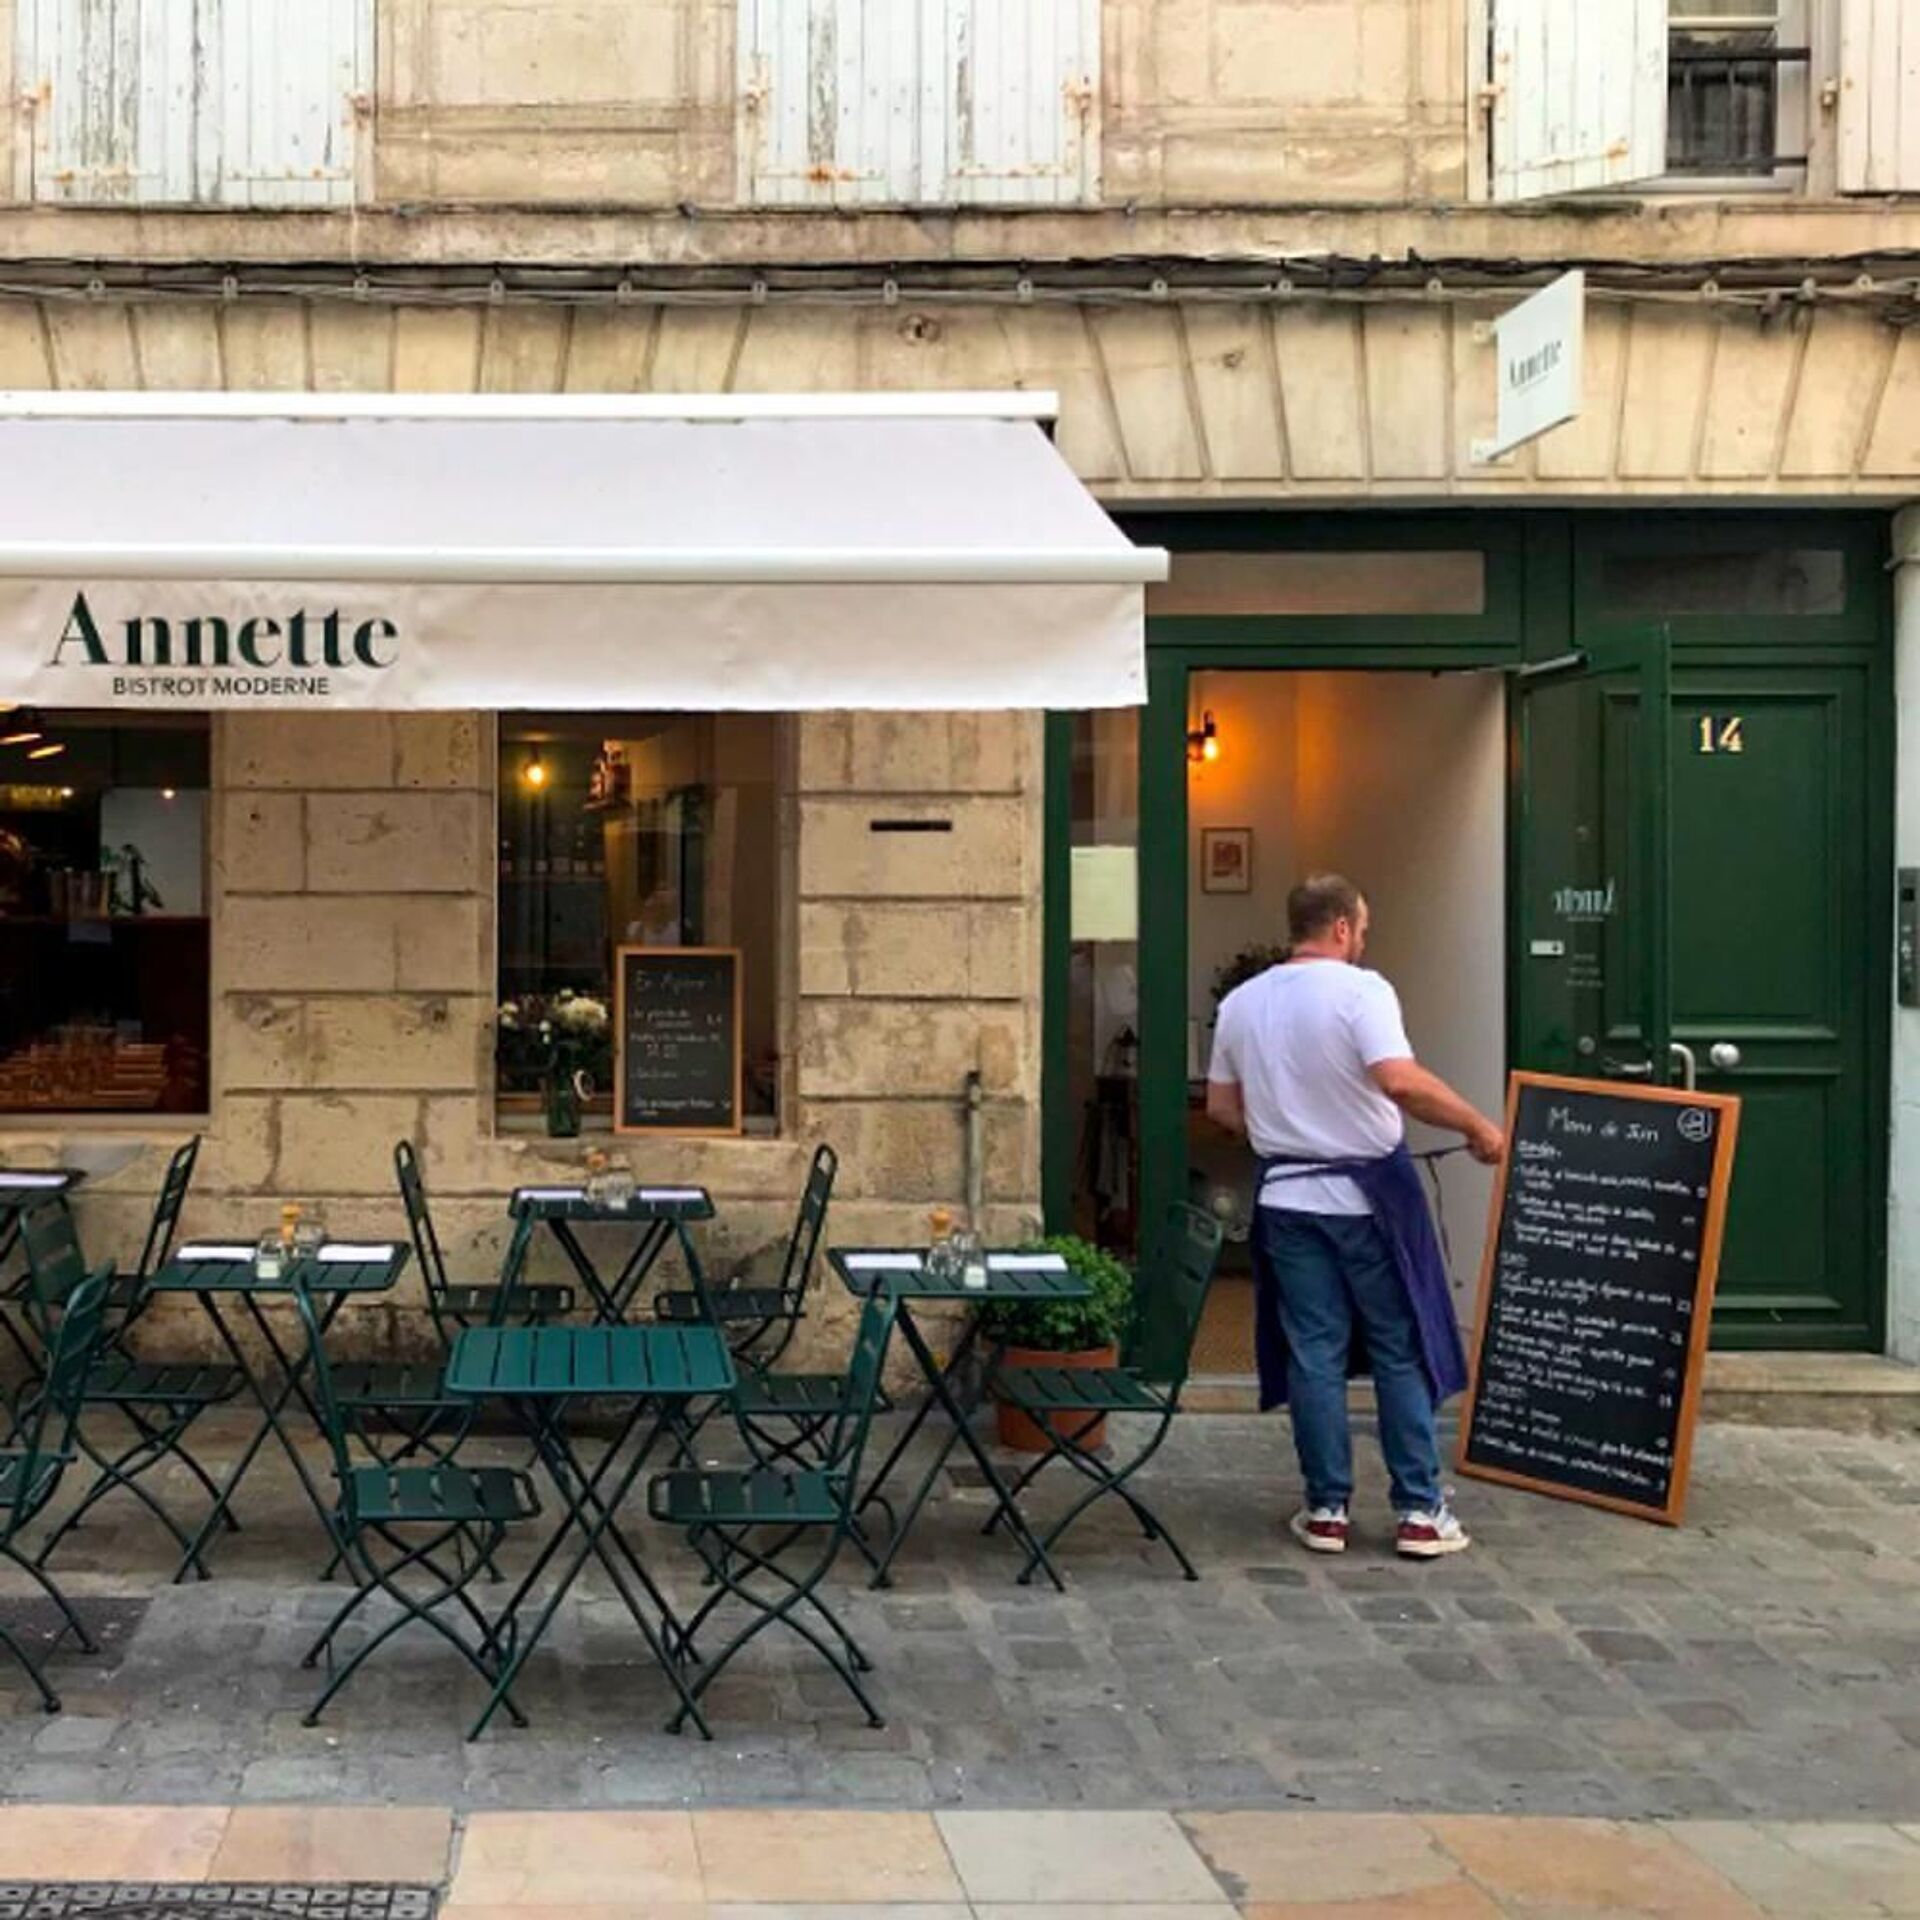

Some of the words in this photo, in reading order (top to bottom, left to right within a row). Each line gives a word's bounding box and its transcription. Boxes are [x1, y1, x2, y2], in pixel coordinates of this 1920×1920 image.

[46, 590, 399, 668] Annette
[113, 677, 206, 697] BISTROT
[213, 676, 331, 696] MODERNE
[1699, 716, 1744, 752] 14
